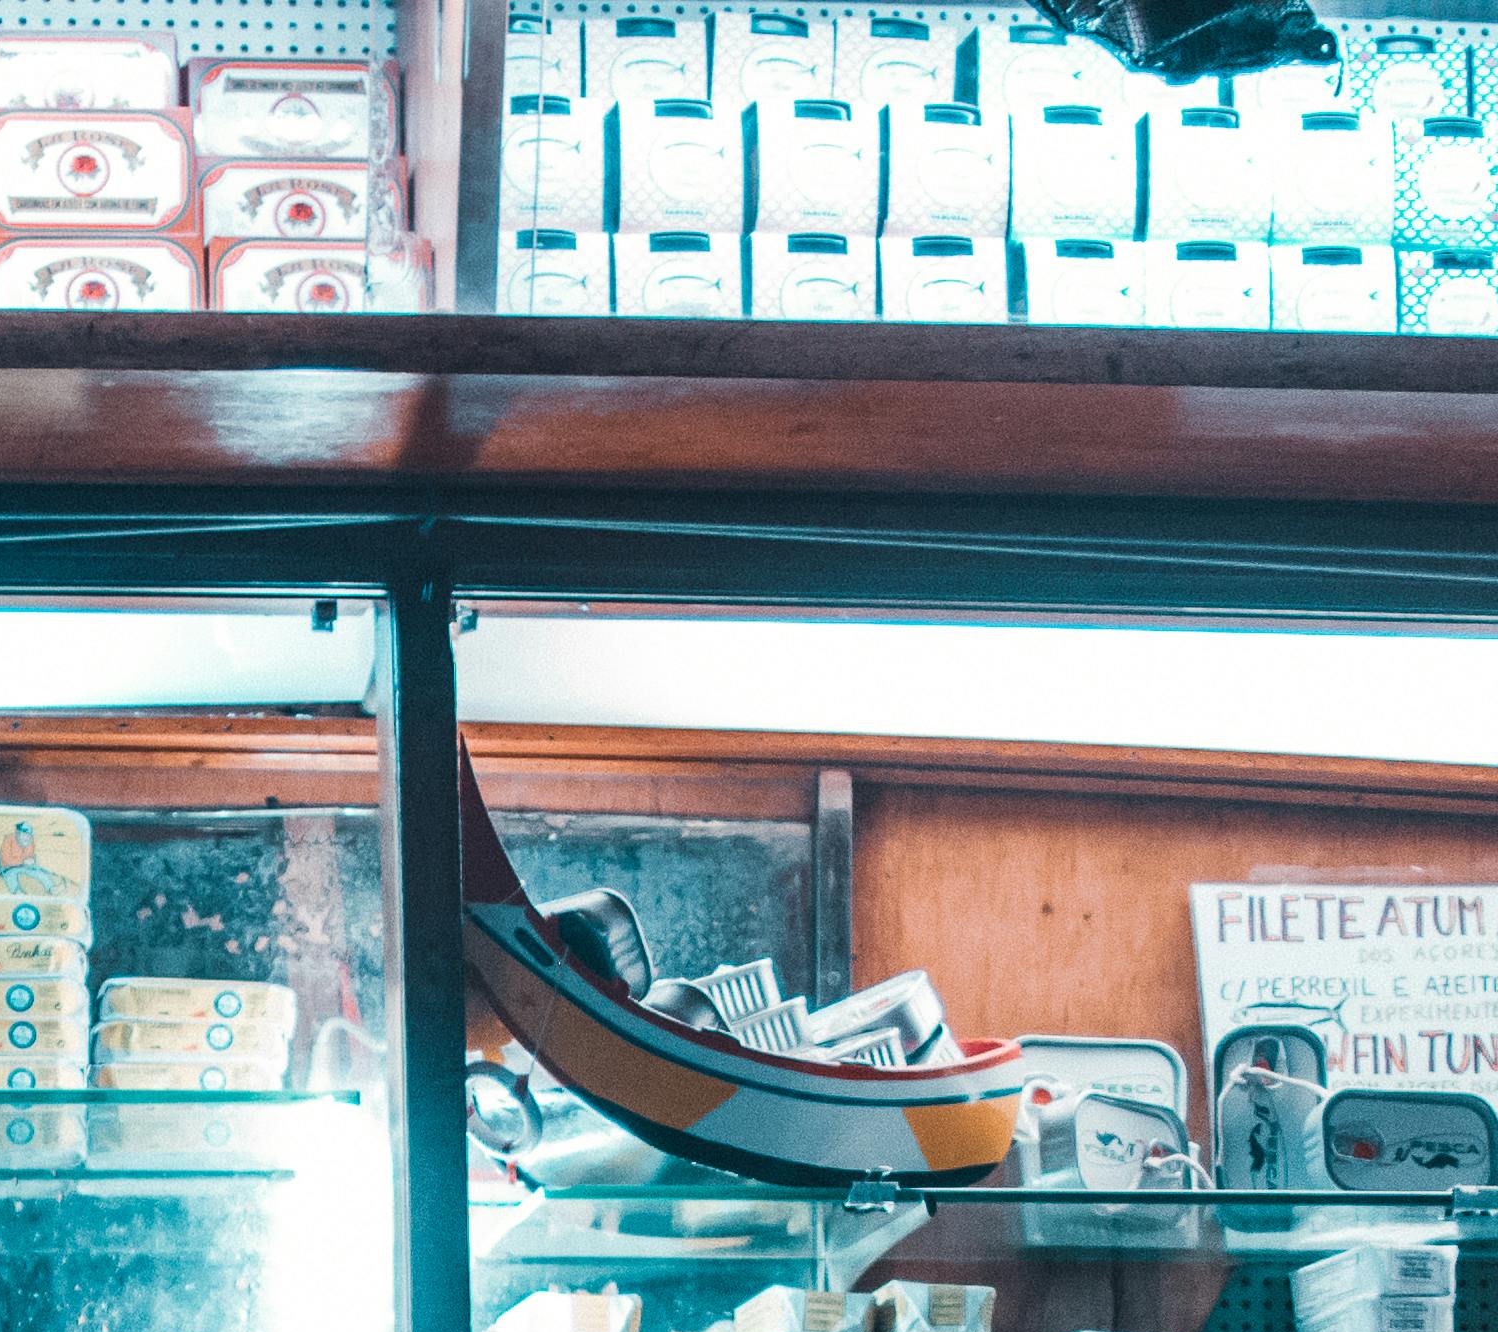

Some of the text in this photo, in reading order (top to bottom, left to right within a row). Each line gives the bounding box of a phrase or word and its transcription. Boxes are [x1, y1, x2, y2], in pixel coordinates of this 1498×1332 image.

[1218, 892, 1364, 942] FILETE
[1377, 894, 1487, 937] ATUM
[1257, 976, 1374, 999] PERREXIL
[1395, 977, 1410, 997] E
[1327, 1033, 1407, 1075] WFIN
